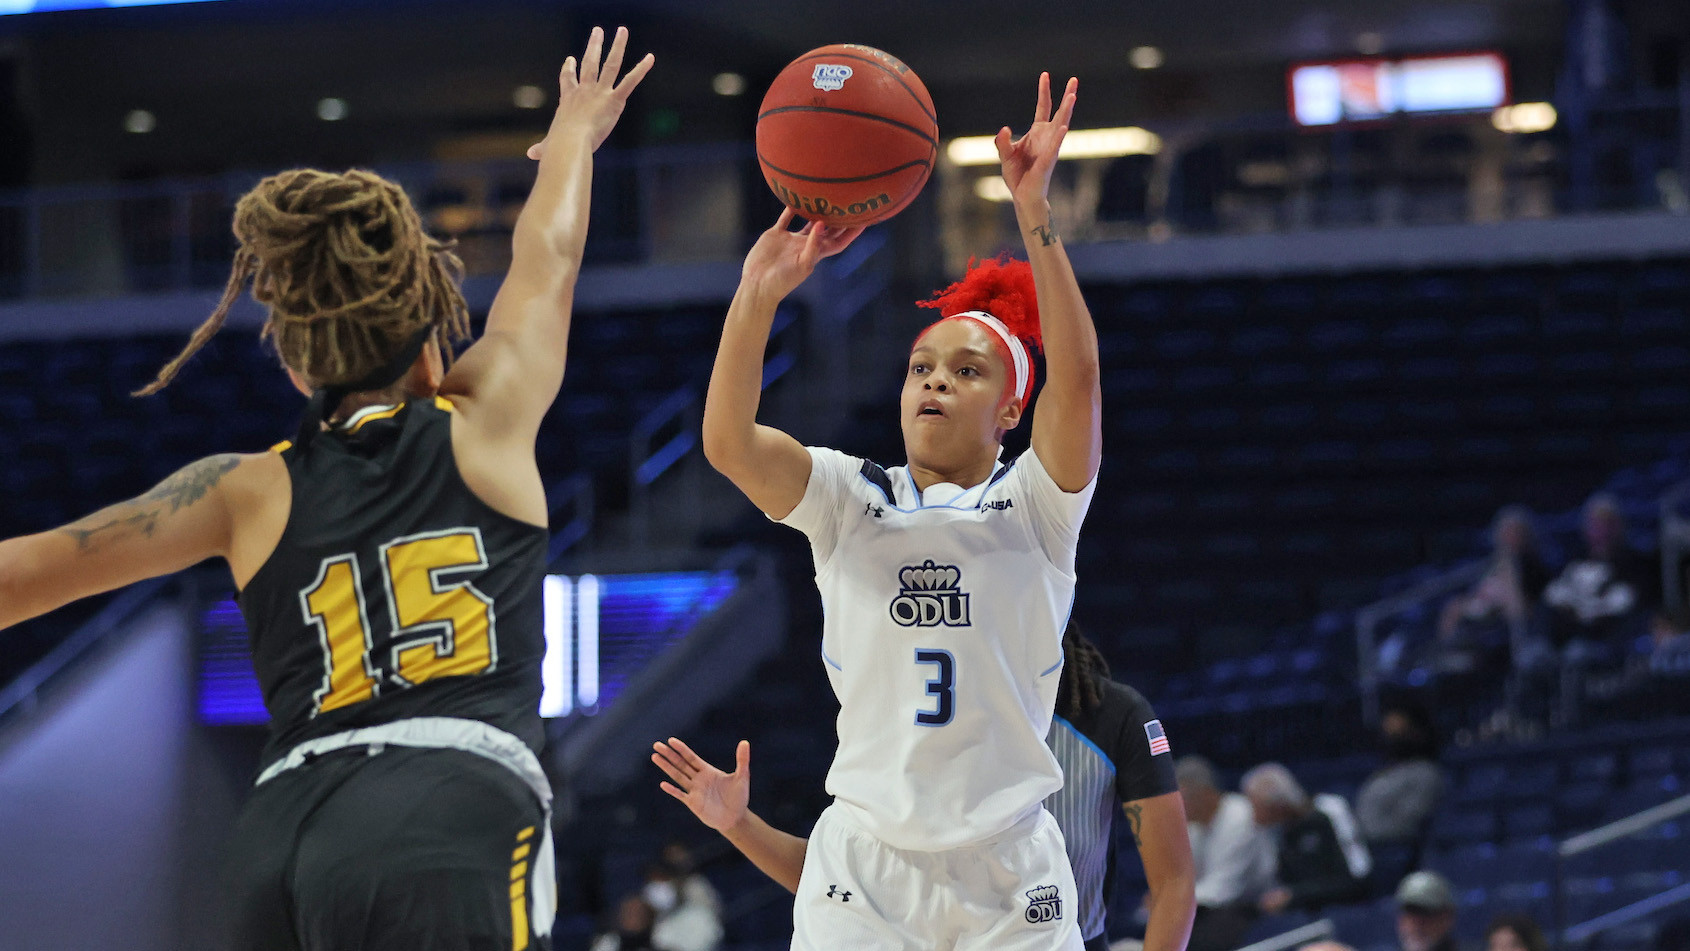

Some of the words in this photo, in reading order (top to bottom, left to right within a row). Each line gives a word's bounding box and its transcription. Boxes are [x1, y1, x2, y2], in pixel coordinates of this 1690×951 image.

[772, 178, 890, 216] Wilson
[299, 526, 498, 719] 15
[890, 594, 971, 627] ODU
[914, 648, 956, 727] 3
[1025, 900, 1062, 923] ODU
